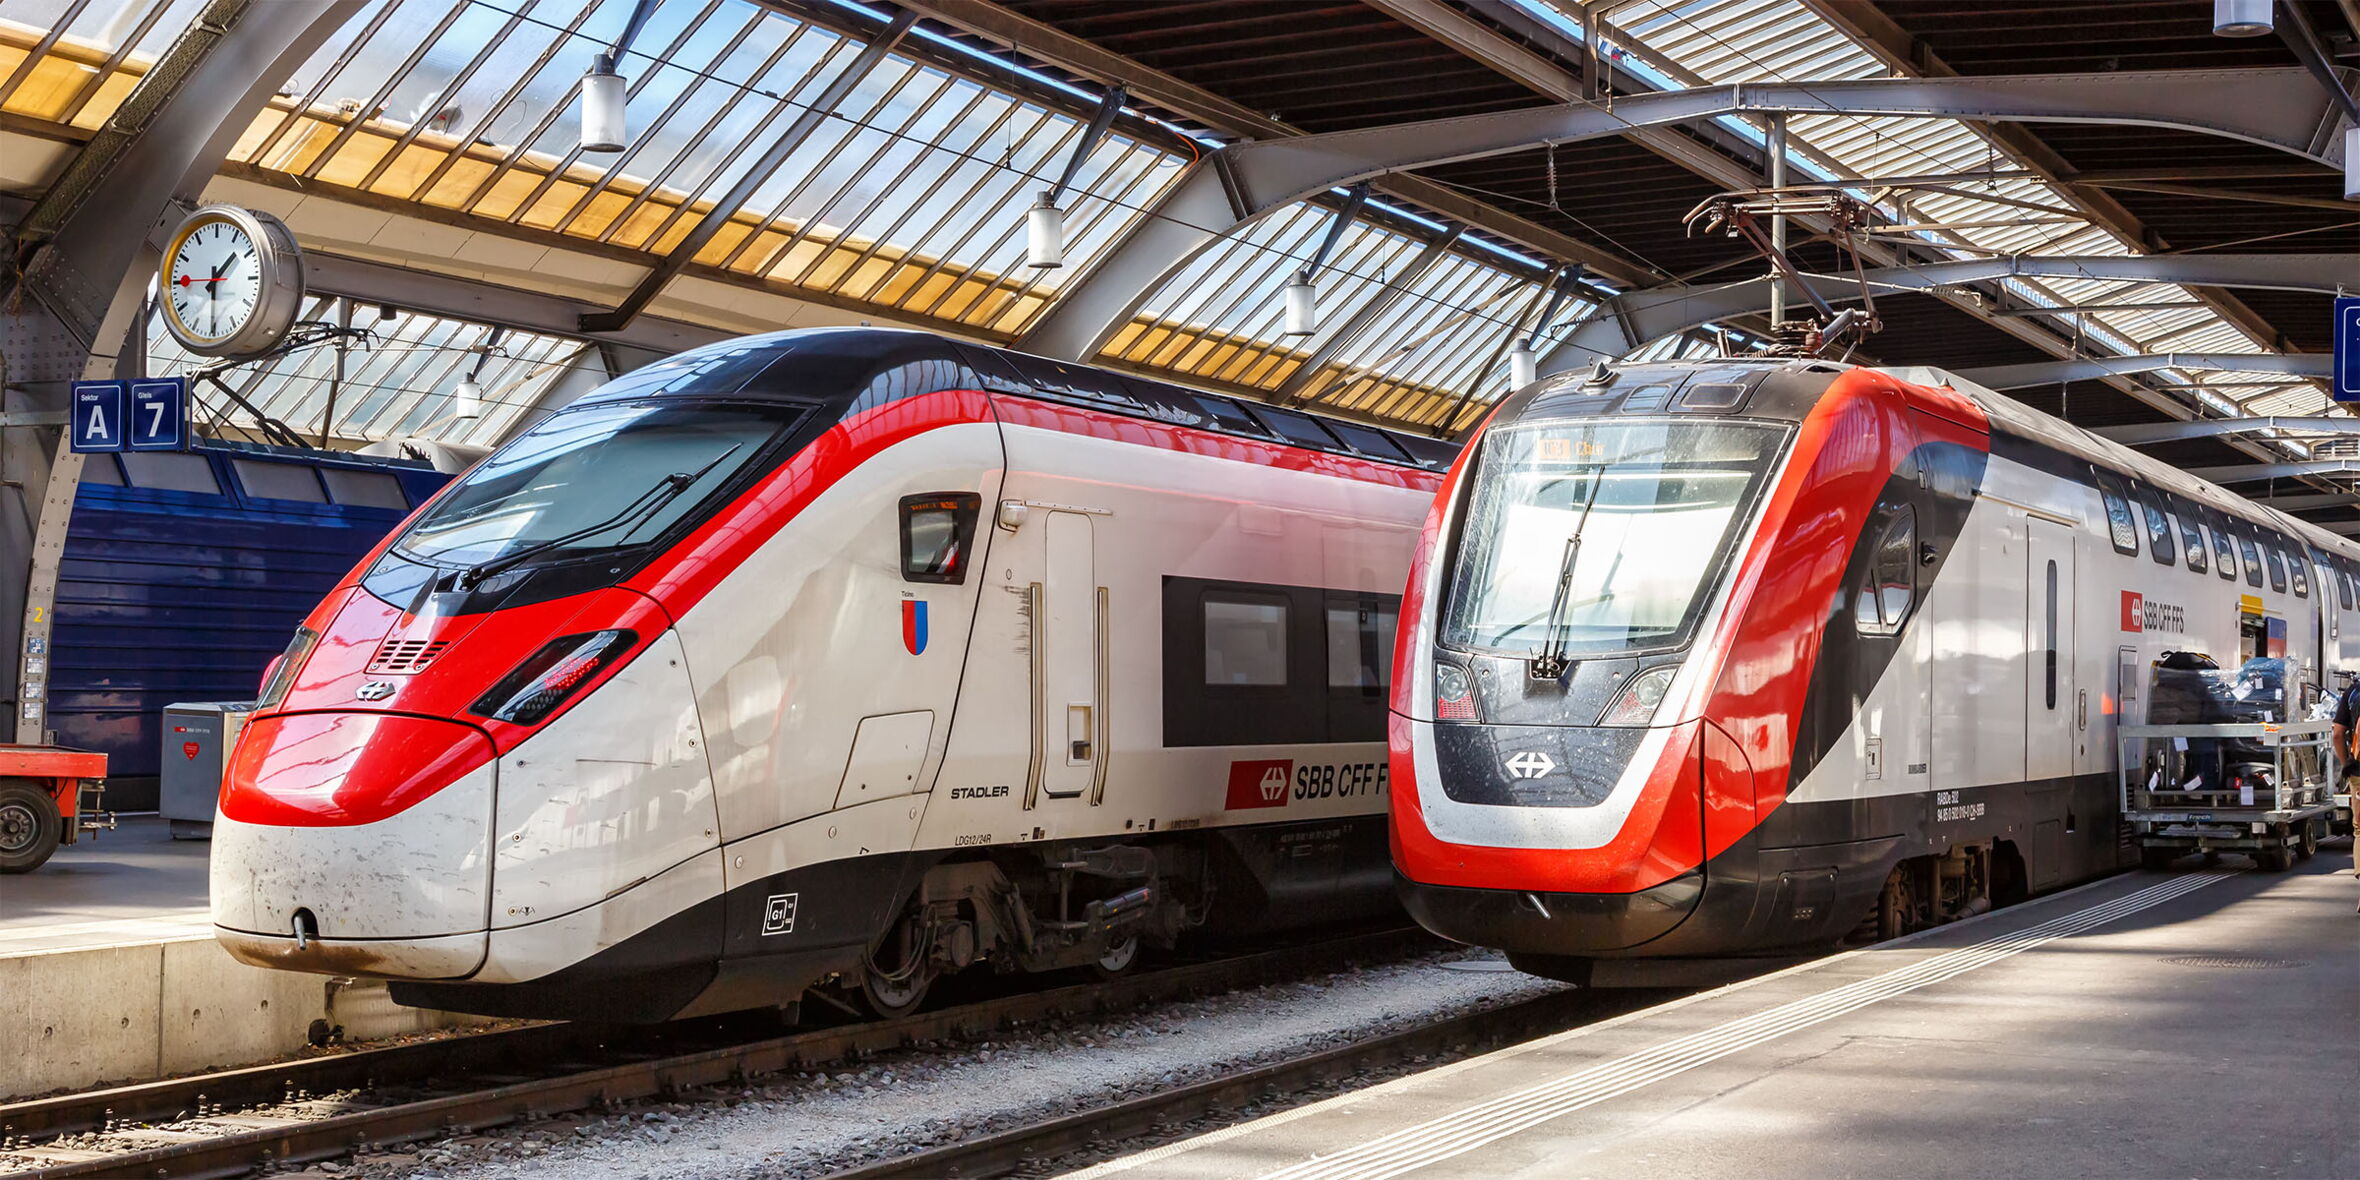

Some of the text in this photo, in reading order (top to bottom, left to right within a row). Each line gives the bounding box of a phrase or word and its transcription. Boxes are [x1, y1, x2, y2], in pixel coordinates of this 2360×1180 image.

[81, 394, 99, 402] Sektor
[86, 405, 108, 439] A
[145, 402, 164, 437] 7
[33, 607, 43, 623] 2
[2144, 600, 2184, 634] SBB CFF FFS
[951, 786, 1009, 799] STADLER
[1295, 765, 1334, 800] SBB
[1338, 763, 1374, 797] CFF
[772, 909, 783, 920] G1
